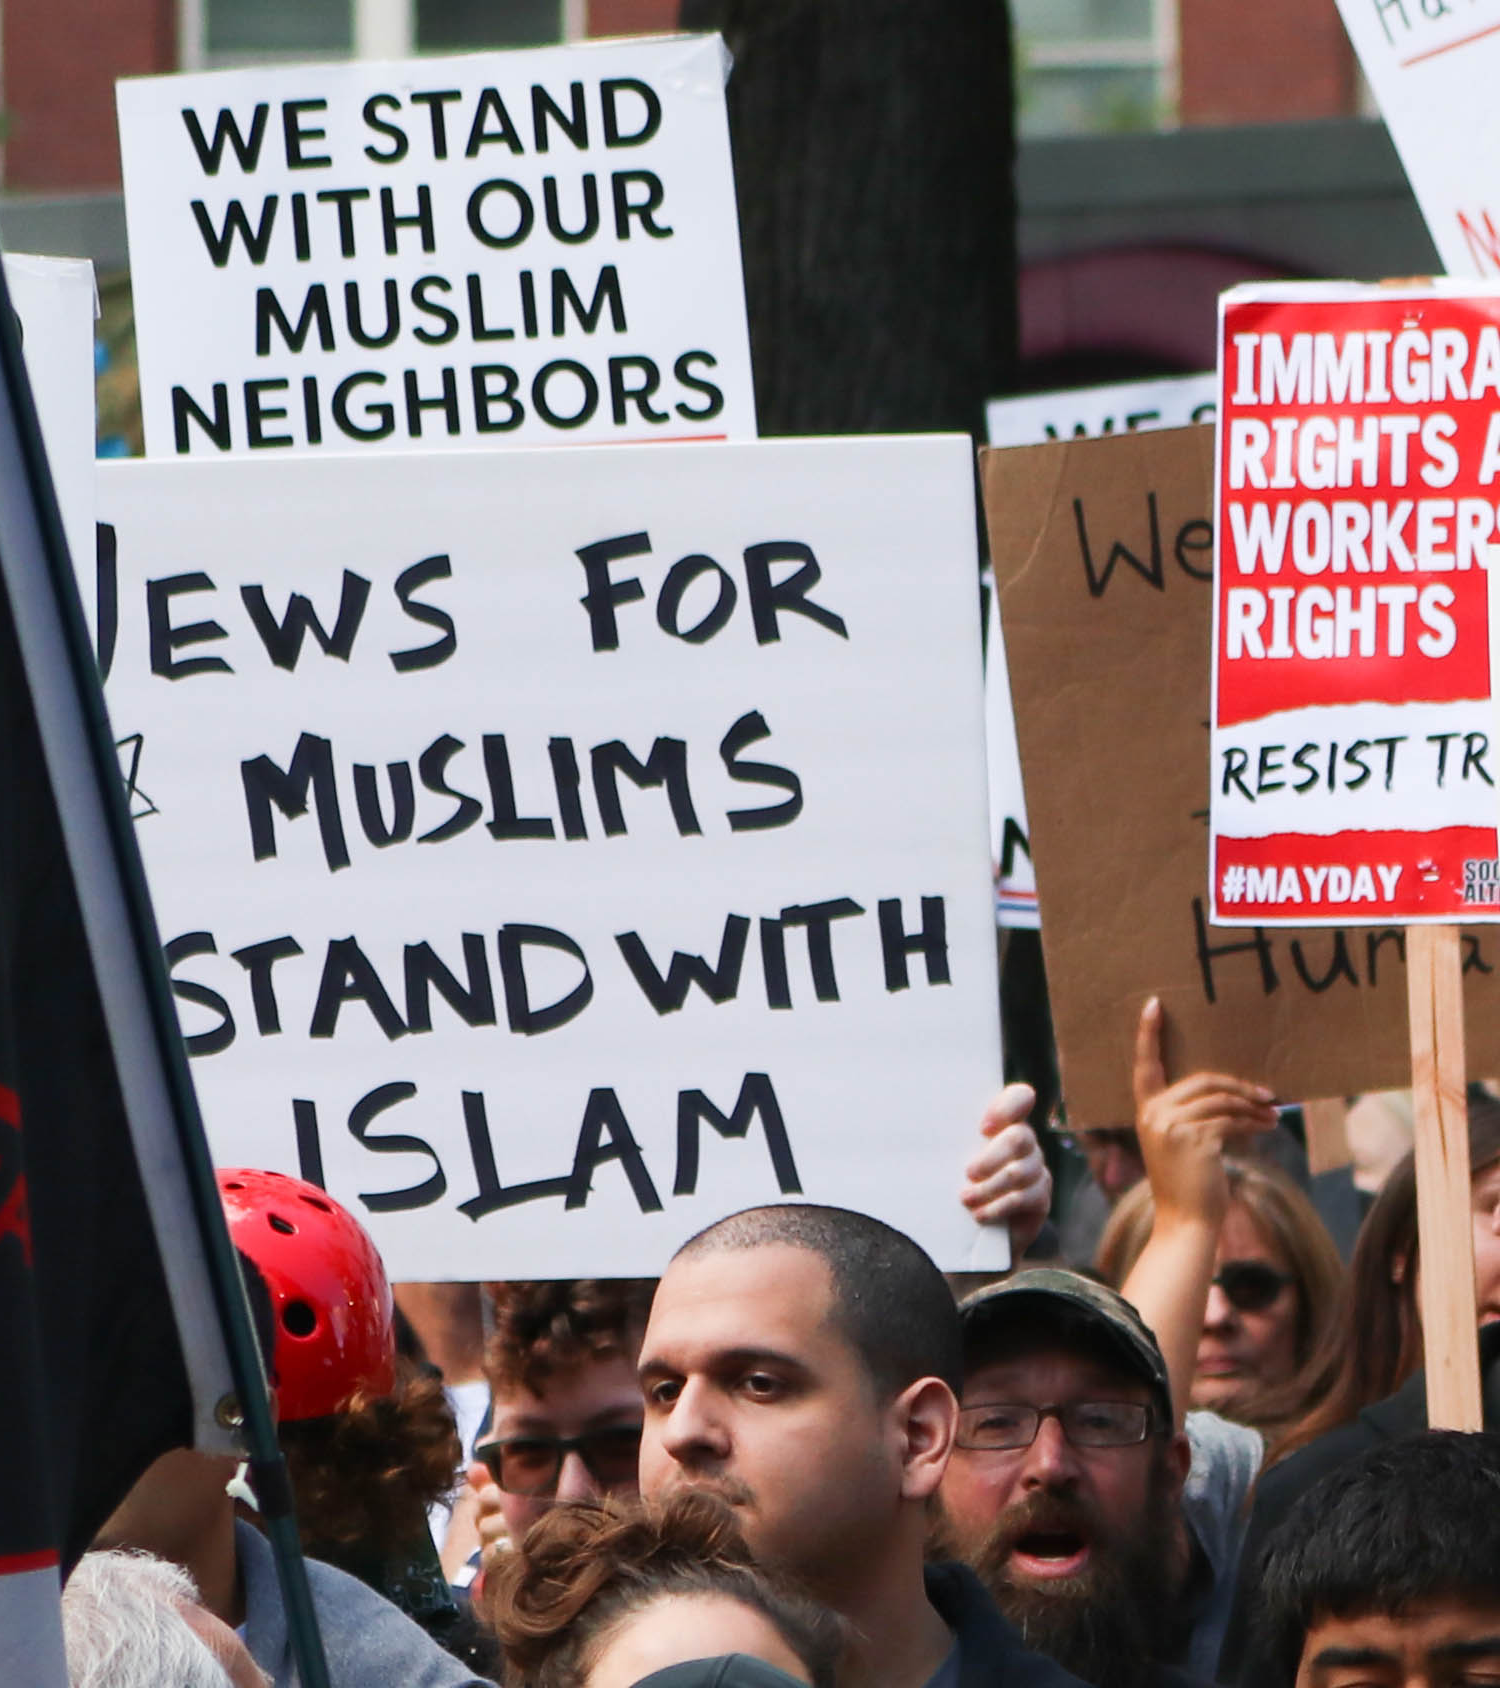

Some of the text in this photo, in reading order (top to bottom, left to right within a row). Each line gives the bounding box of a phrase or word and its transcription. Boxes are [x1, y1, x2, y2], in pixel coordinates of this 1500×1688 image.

[180, 77, 663, 174] WE STAND
[189, 169, 673, 268] WITH OUR
[256, 265, 628, 357] MUSLIM
[172, 350, 725, 454] NEIGHBORS
[1227, 414, 1459, 490] RIGHTS
[575, 531, 849, 652] FOR
[1225, 584, 1458, 661] RIGHTS
[240, 710, 803, 871] MUSLIMS
[1221, 733, 1408, 803] RESIST
[1220, 864, 1403, 905] #MAYDAY
[165, 895, 952, 1058] STAND WITH
[292, 1072, 803, 1222] ISLAM
